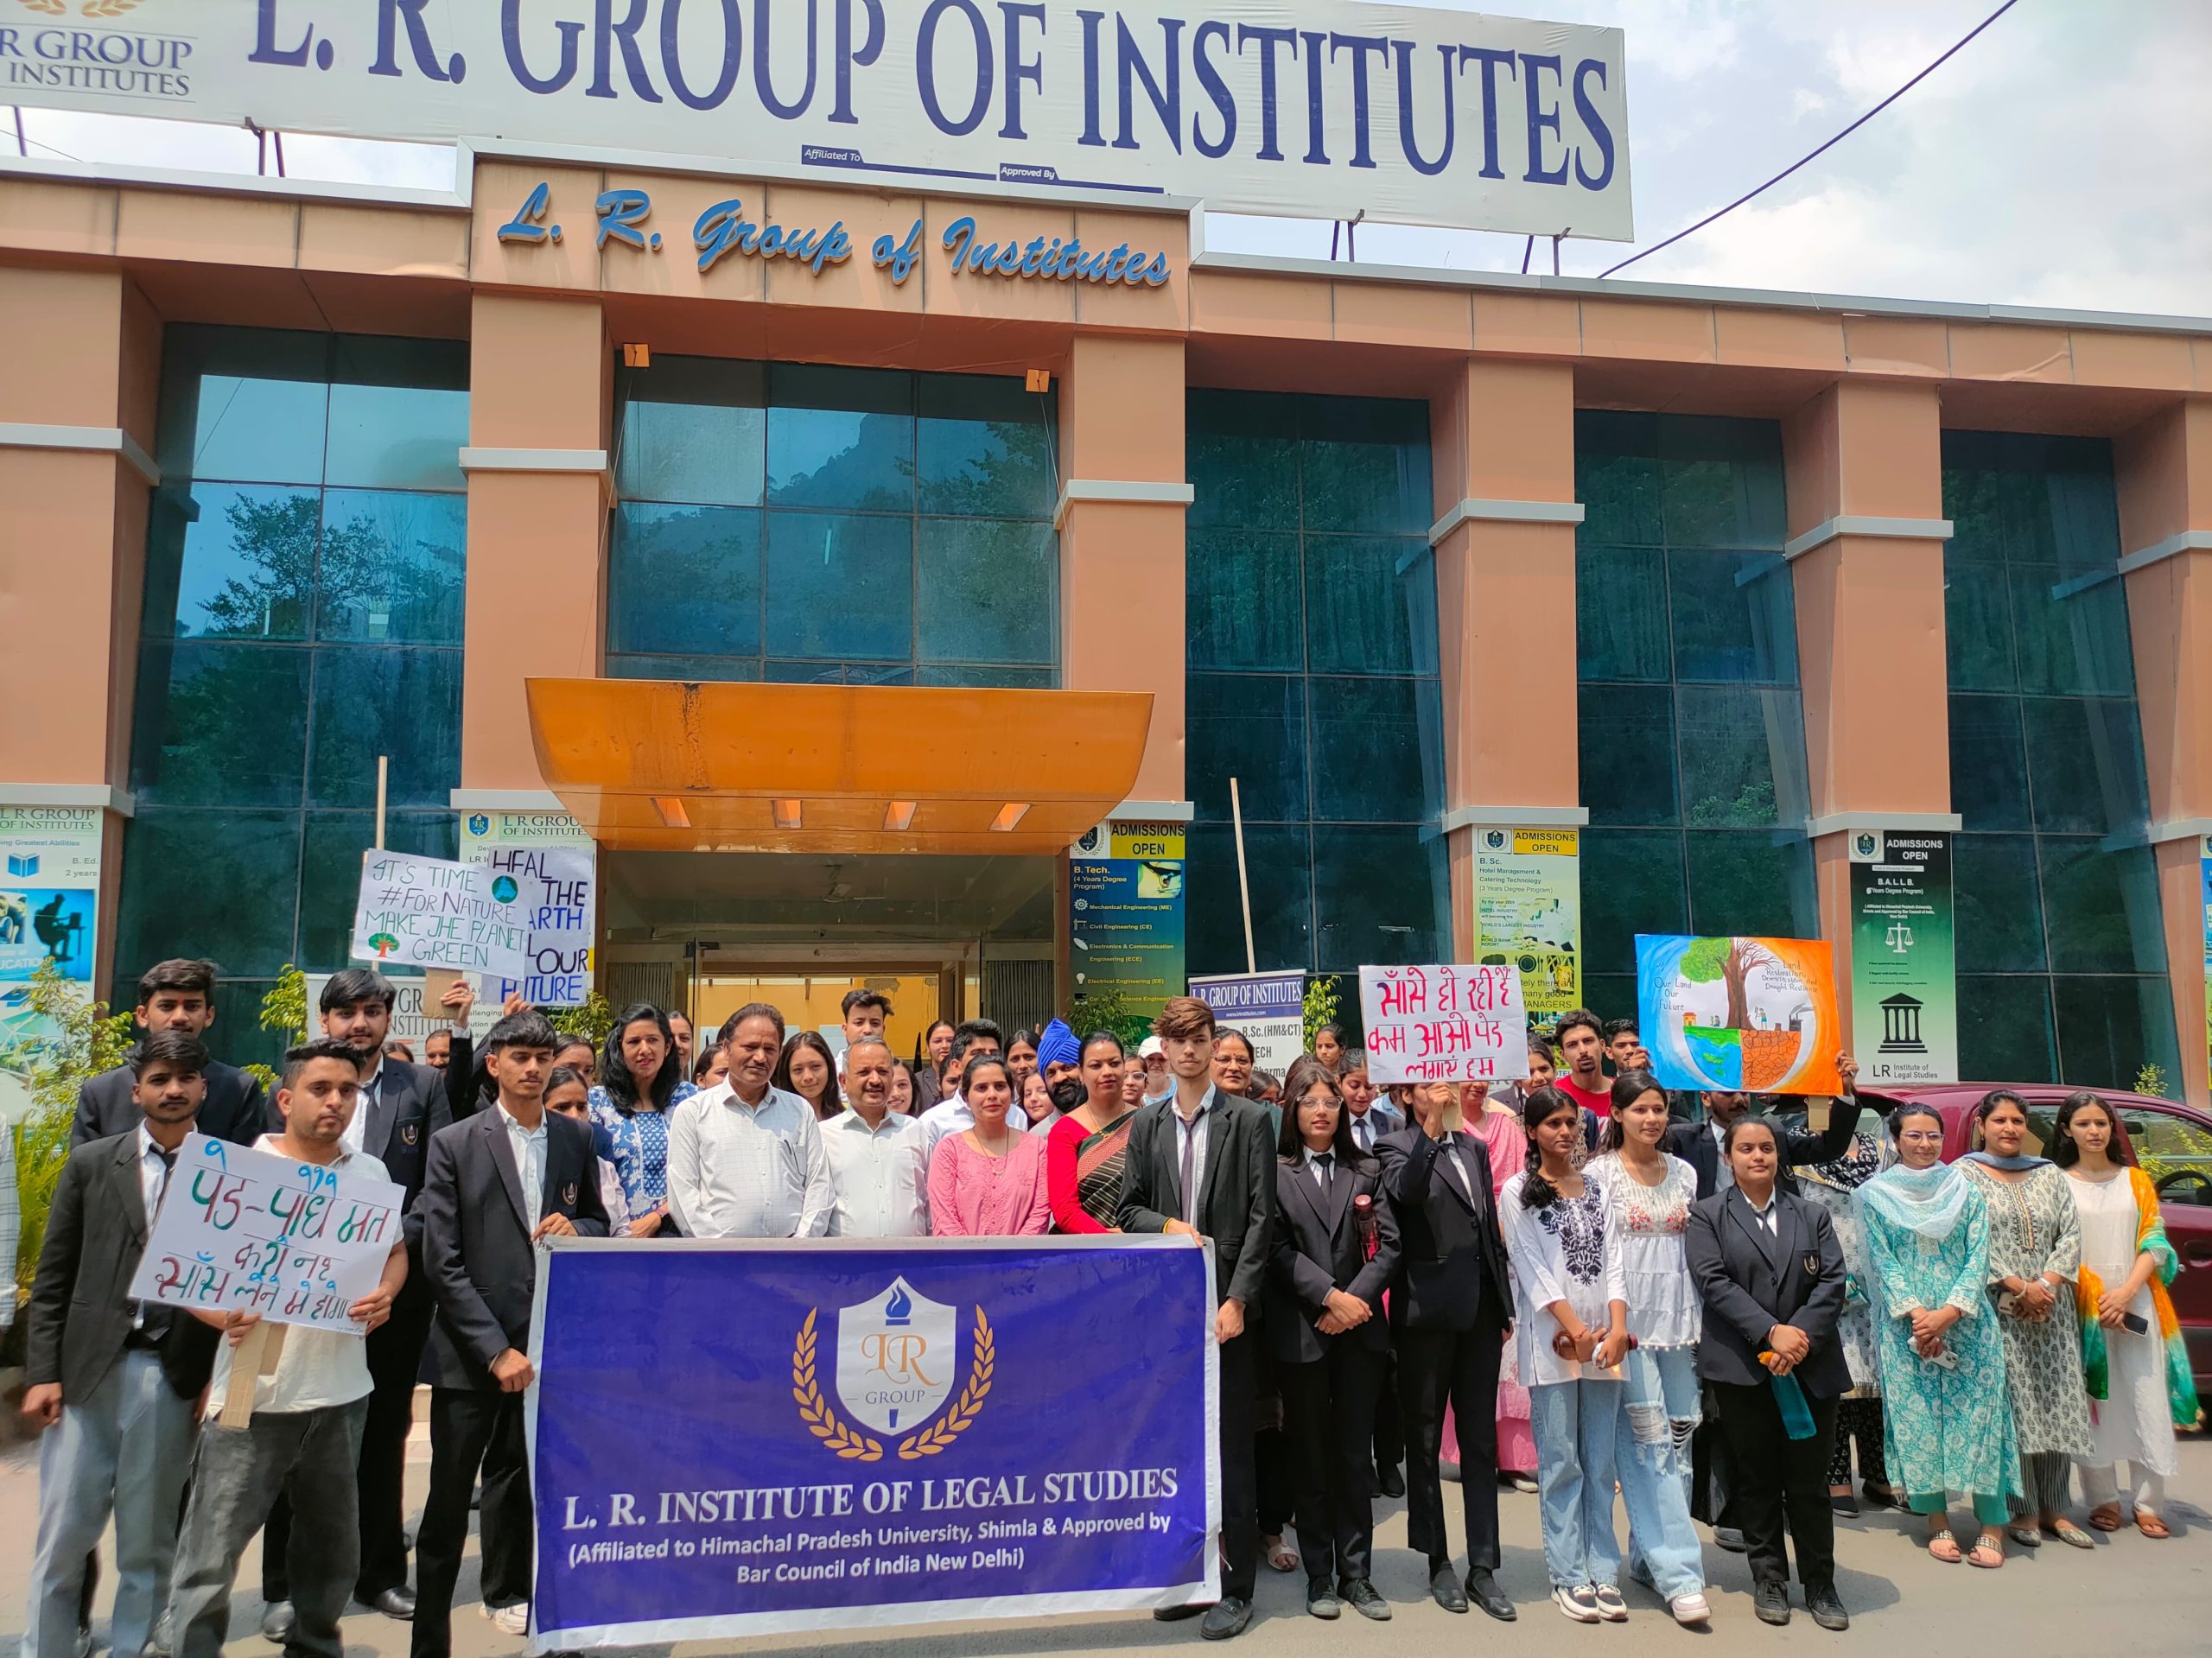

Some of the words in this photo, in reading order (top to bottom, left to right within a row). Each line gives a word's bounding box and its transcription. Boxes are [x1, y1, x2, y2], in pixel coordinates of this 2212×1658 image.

[35, 30, 193, 70] GROUP
[10, 61, 191, 97] INSTITUTES
[501, 0, 885, 124] GROUP
[916, 0, 1046, 141] OF
[1077, 9, 1614, 191] INSTITUTES
[804, 149, 847, 162] Affiliated
[850, 152, 861, 162] To
[1001, 166, 1042, 178] Approved
[1044, 169, 1055, 180] By
[498, 182, 563, 245] L.
[595, 189, 664, 252] R.
[694, 199, 853, 276] Group
[872, 219, 925, 286] of
[943, 217, 1172, 288] Institutes
[0, 809, 10, 819] L
[14, 809, 27, 819] R
[31, 809, 95, 821] GROUP
[505, 816, 512, 826] L
[518, 816, 529, 826] R
[21, 821, 94, 829] INSTITUTES
[504, 828, 519, 836] OF
[1111, 824, 1185, 836] ADMISSIONS
[1515, 832, 1575, 842] ADMISSIONS
[1886, 839, 1943, 849] ADMISSIONS
[1133, 842, 1165, 855] OPEN
[1902, 851, 1929, 861] OPEN
[493, 850, 552, 880] HEAL
[429, 866, 480, 893] TIME
[541, 880, 588, 907] THE
[442, 892, 517, 924] NATURE
[529, 906, 583, 931] ARTH
[364, 911, 423, 936] MAKE
[469, 921, 525, 953] PLANET
[412, 938, 489, 967] GREEN
[537, 948, 588, 975] OUR
[1783, 960, 1801, 969] Land
[1654, 977, 1672, 989] Our
[1675, 977, 1692, 989] Land
[1210, 987, 1238, 1007] GROUP
[1240, 985, 1251, 1005] OF
[1253, 981, 1301, 1004] INSTITUTES
[1664, 989, 1679, 998] Our
[1659, 1000, 1685, 1011] Future
[1873, 1064, 1891, 1077] LR
[865, 1389, 925, 1404] GROUP
[563, 1496, 598, 1530] L.
[608, 1493, 646, 1527] R.
[657, 1483, 854, 1524] INSTITUTE
[863, 1481, 912, 1515] OF
[921, 1475, 1036, 1511] LEGAL
[1043, 1467, 1179, 1504] STUDIES
[569, 1538, 670, 1569] (Affiliated
[674, 1540, 695, 1557] to
[701, 1533, 791, 1556] Himachal
[797, 1528, 873, 1551] Pradesh
[879, 1524, 973, 1546] University,
[977, 1518, 1037, 1540] Shimla
[1042, 1517, 1057, 1535] &
[1061, 1512, 1144, 1538] Approved
[1149, 1511, 1172, 1534] by
[737, 1565, 771, 1584] Bar
[775, 1560, 845, 1581] Council
[850, 1557, 870, 1576] of
[874, 1554, 920, 1575] India
[926, 1553, 968, 1572] New
[971, 1547, 1025, 1570] Delhi)
